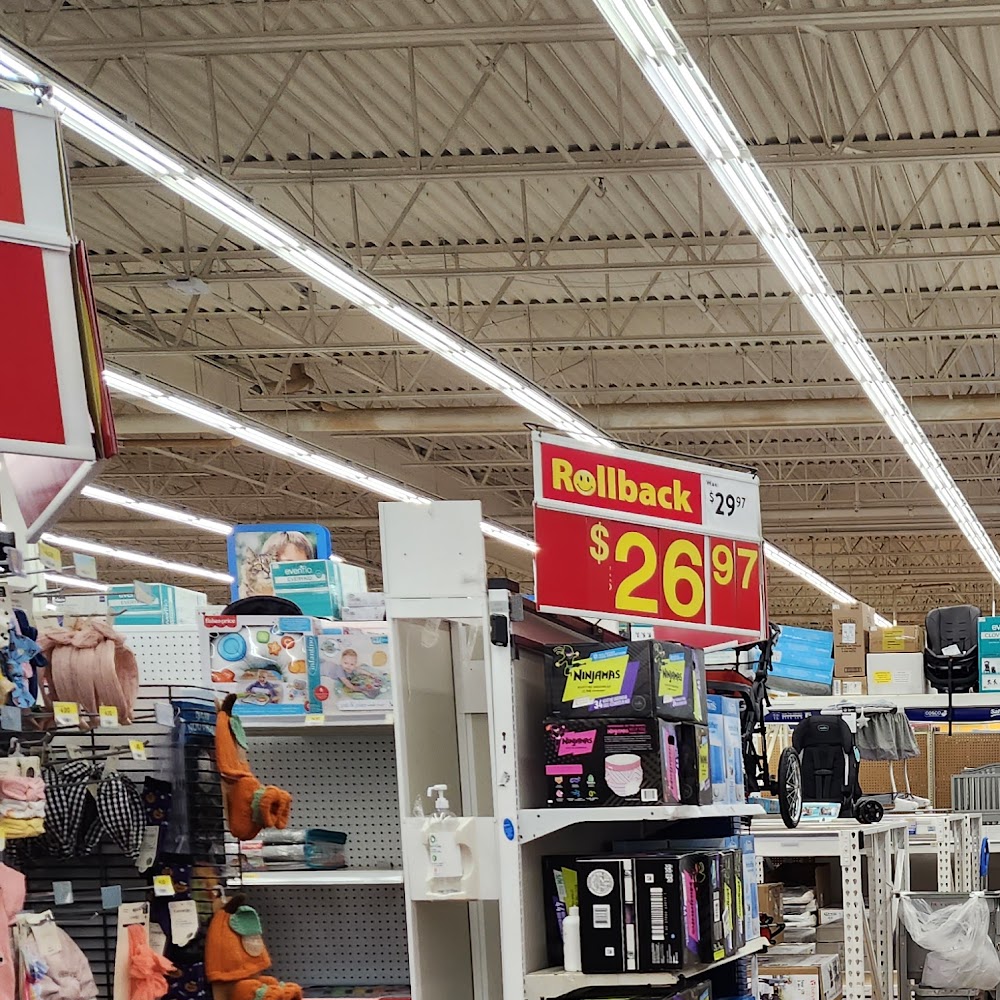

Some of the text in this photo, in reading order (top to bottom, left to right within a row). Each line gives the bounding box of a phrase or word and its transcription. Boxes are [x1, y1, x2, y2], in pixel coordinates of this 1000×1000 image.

[552, 458, 693, 513] Rollback
[284, 565, 312, 575] evenflo
[573, 669, 621, 684] NINJAMAS
